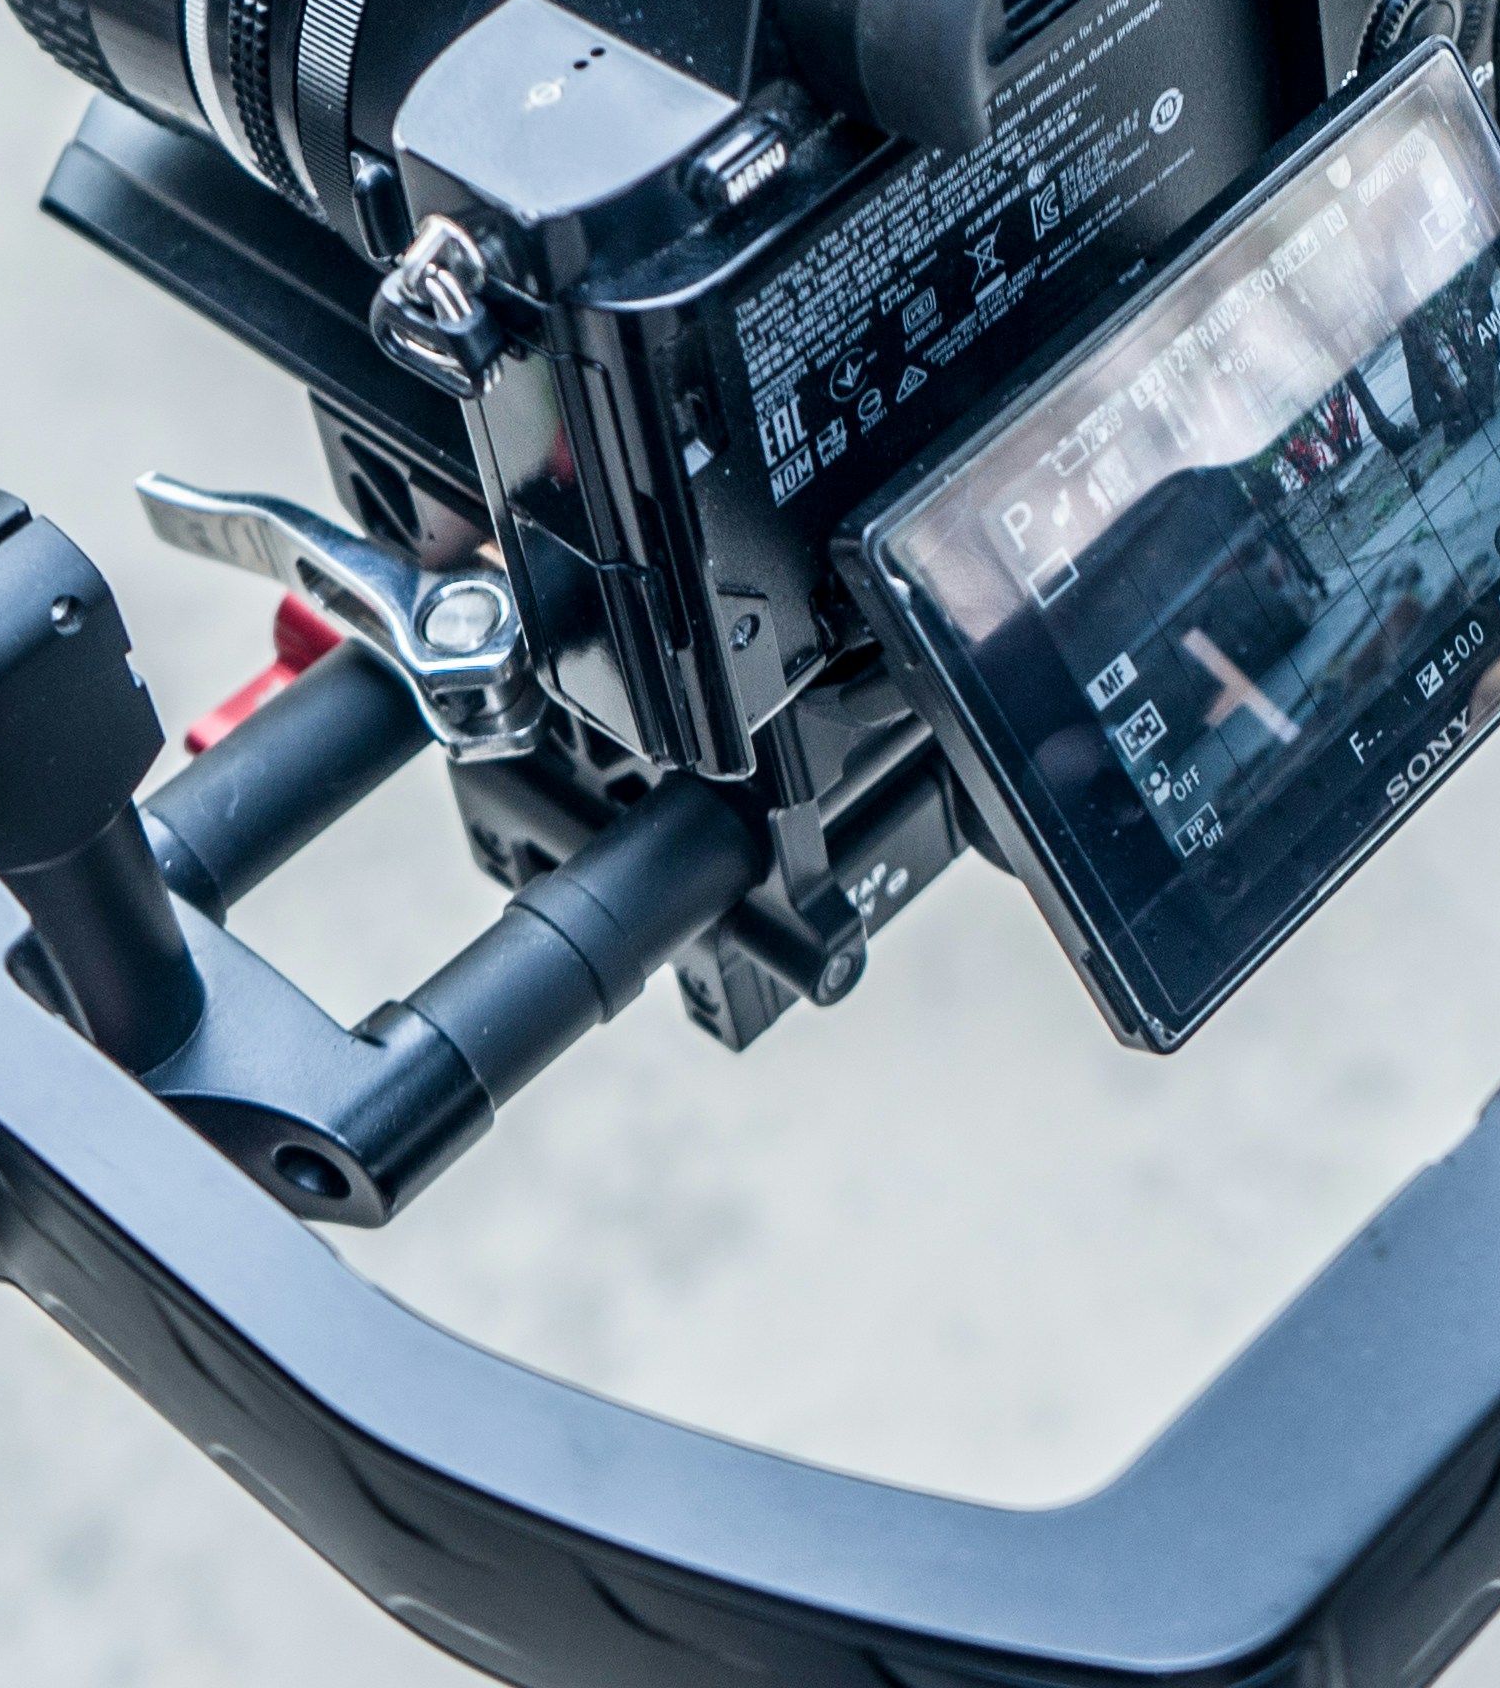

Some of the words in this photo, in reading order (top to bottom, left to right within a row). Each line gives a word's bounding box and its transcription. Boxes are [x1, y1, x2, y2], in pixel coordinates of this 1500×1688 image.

[1014, 57, 1047, 95] power
[1061, 33, 1076, 55] on
[1078, 17, 1094, 41] for
[1028, 71, 1067, 114] pendant
[1067, 56, 1087, 81] une
[726, 141, 787, 205] MENU
[769, 446, 815, 504] NOM
[1002, 500, 1033, 554] P
[1097, 663, 1126, 700] MF
[1171, 763, 1202, 802] OFF
[1384, 705, 1471, 807] SONY
[1186, 816, 1205, 843] PP
[1202, 820, 1225, 850] OFF
